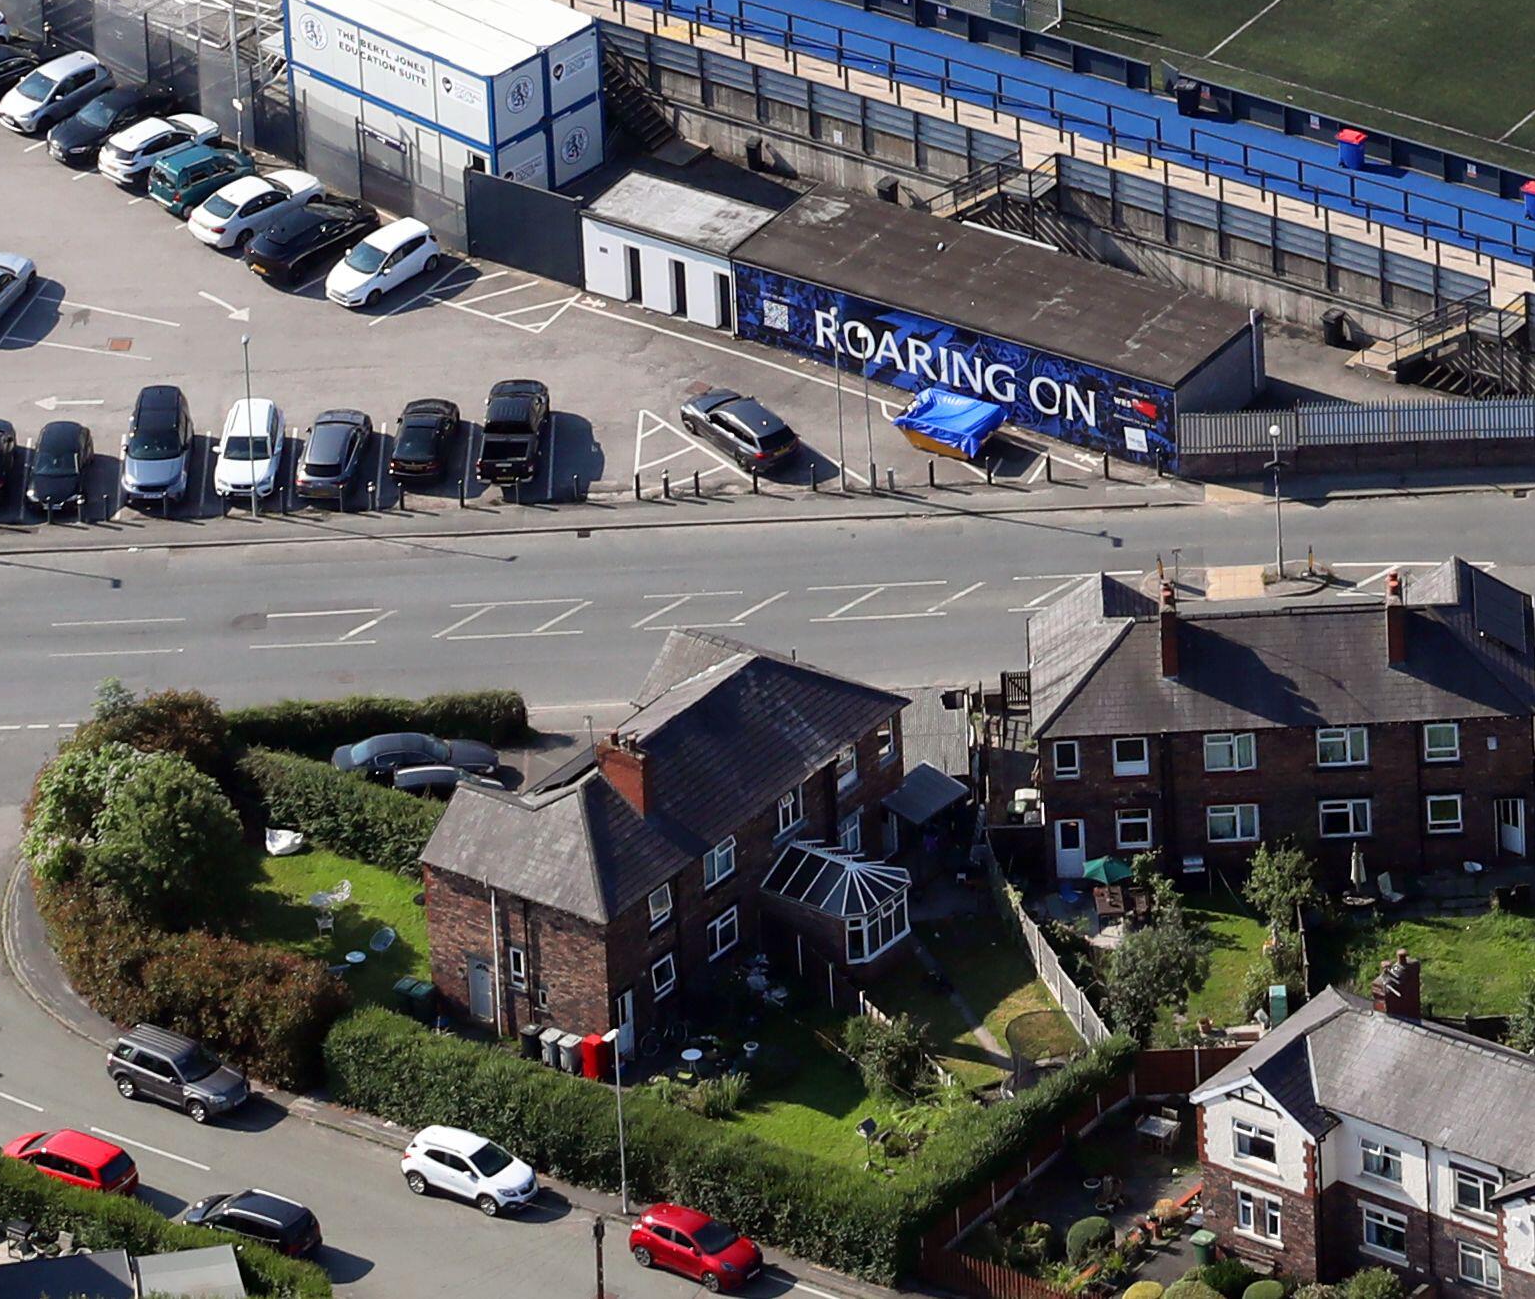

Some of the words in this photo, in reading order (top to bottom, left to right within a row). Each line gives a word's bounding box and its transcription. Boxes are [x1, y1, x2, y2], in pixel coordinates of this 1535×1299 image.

[336, 27, 357, 44] THE
[360, 38, 392, 60] BERYL
[394, 53, 427, 75] JONES
[337, 41, 397, 74] EDUCATION
[399, 68, 428, 87] SUITE
[814, 309, 1017, 403] ROARING
[1029, 376, 1096, 427] ON
